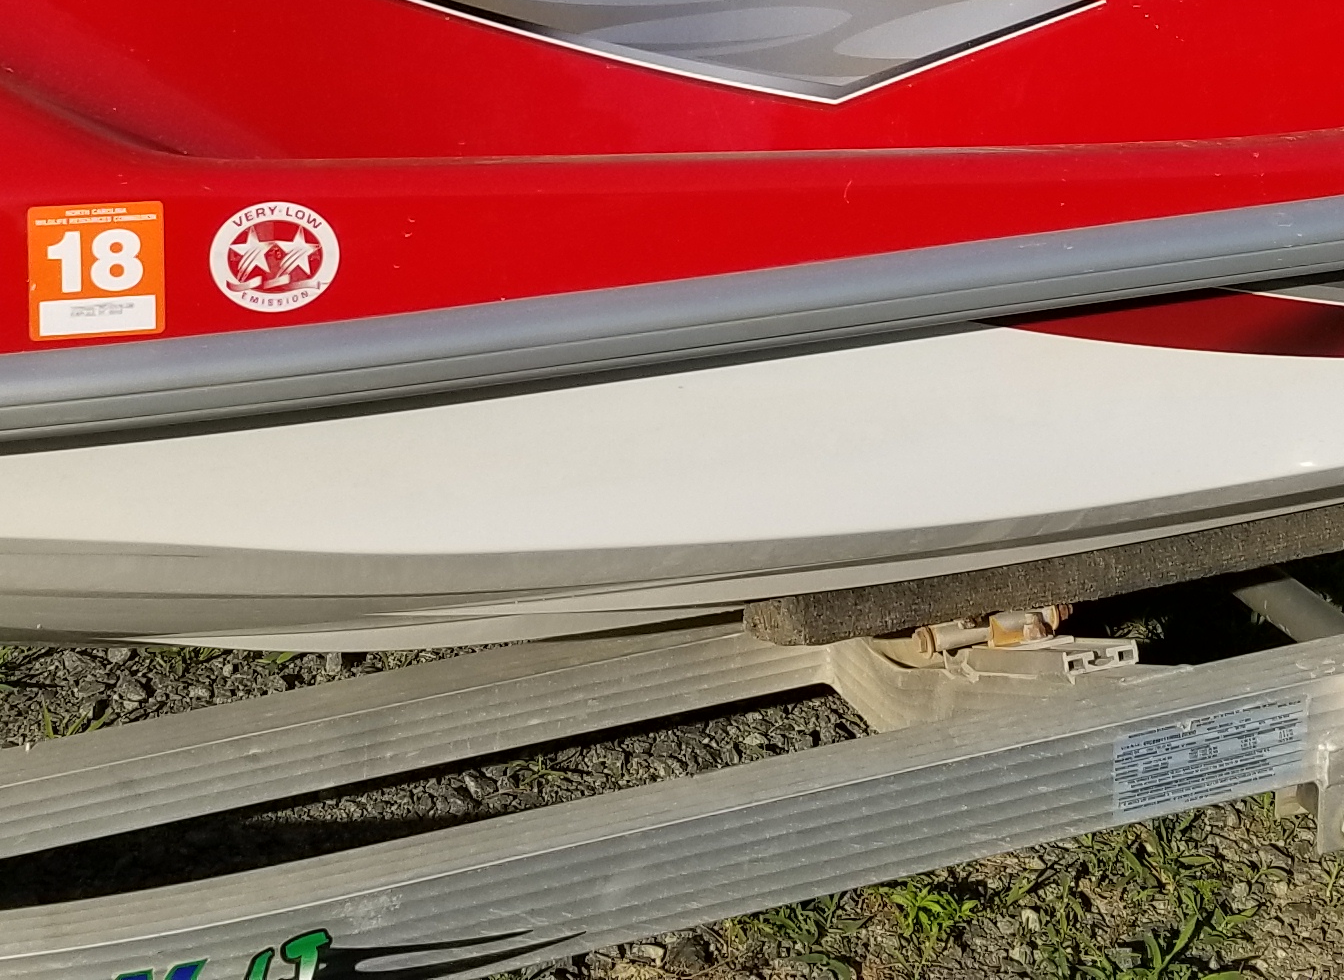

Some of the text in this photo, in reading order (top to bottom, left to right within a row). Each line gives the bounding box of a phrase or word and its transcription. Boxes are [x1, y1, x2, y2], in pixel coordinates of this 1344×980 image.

[232, 205, 323, 229] VERY LOW
[46, 228, 144, 293] 18
[241, 290, 309, 307] EMISSION
